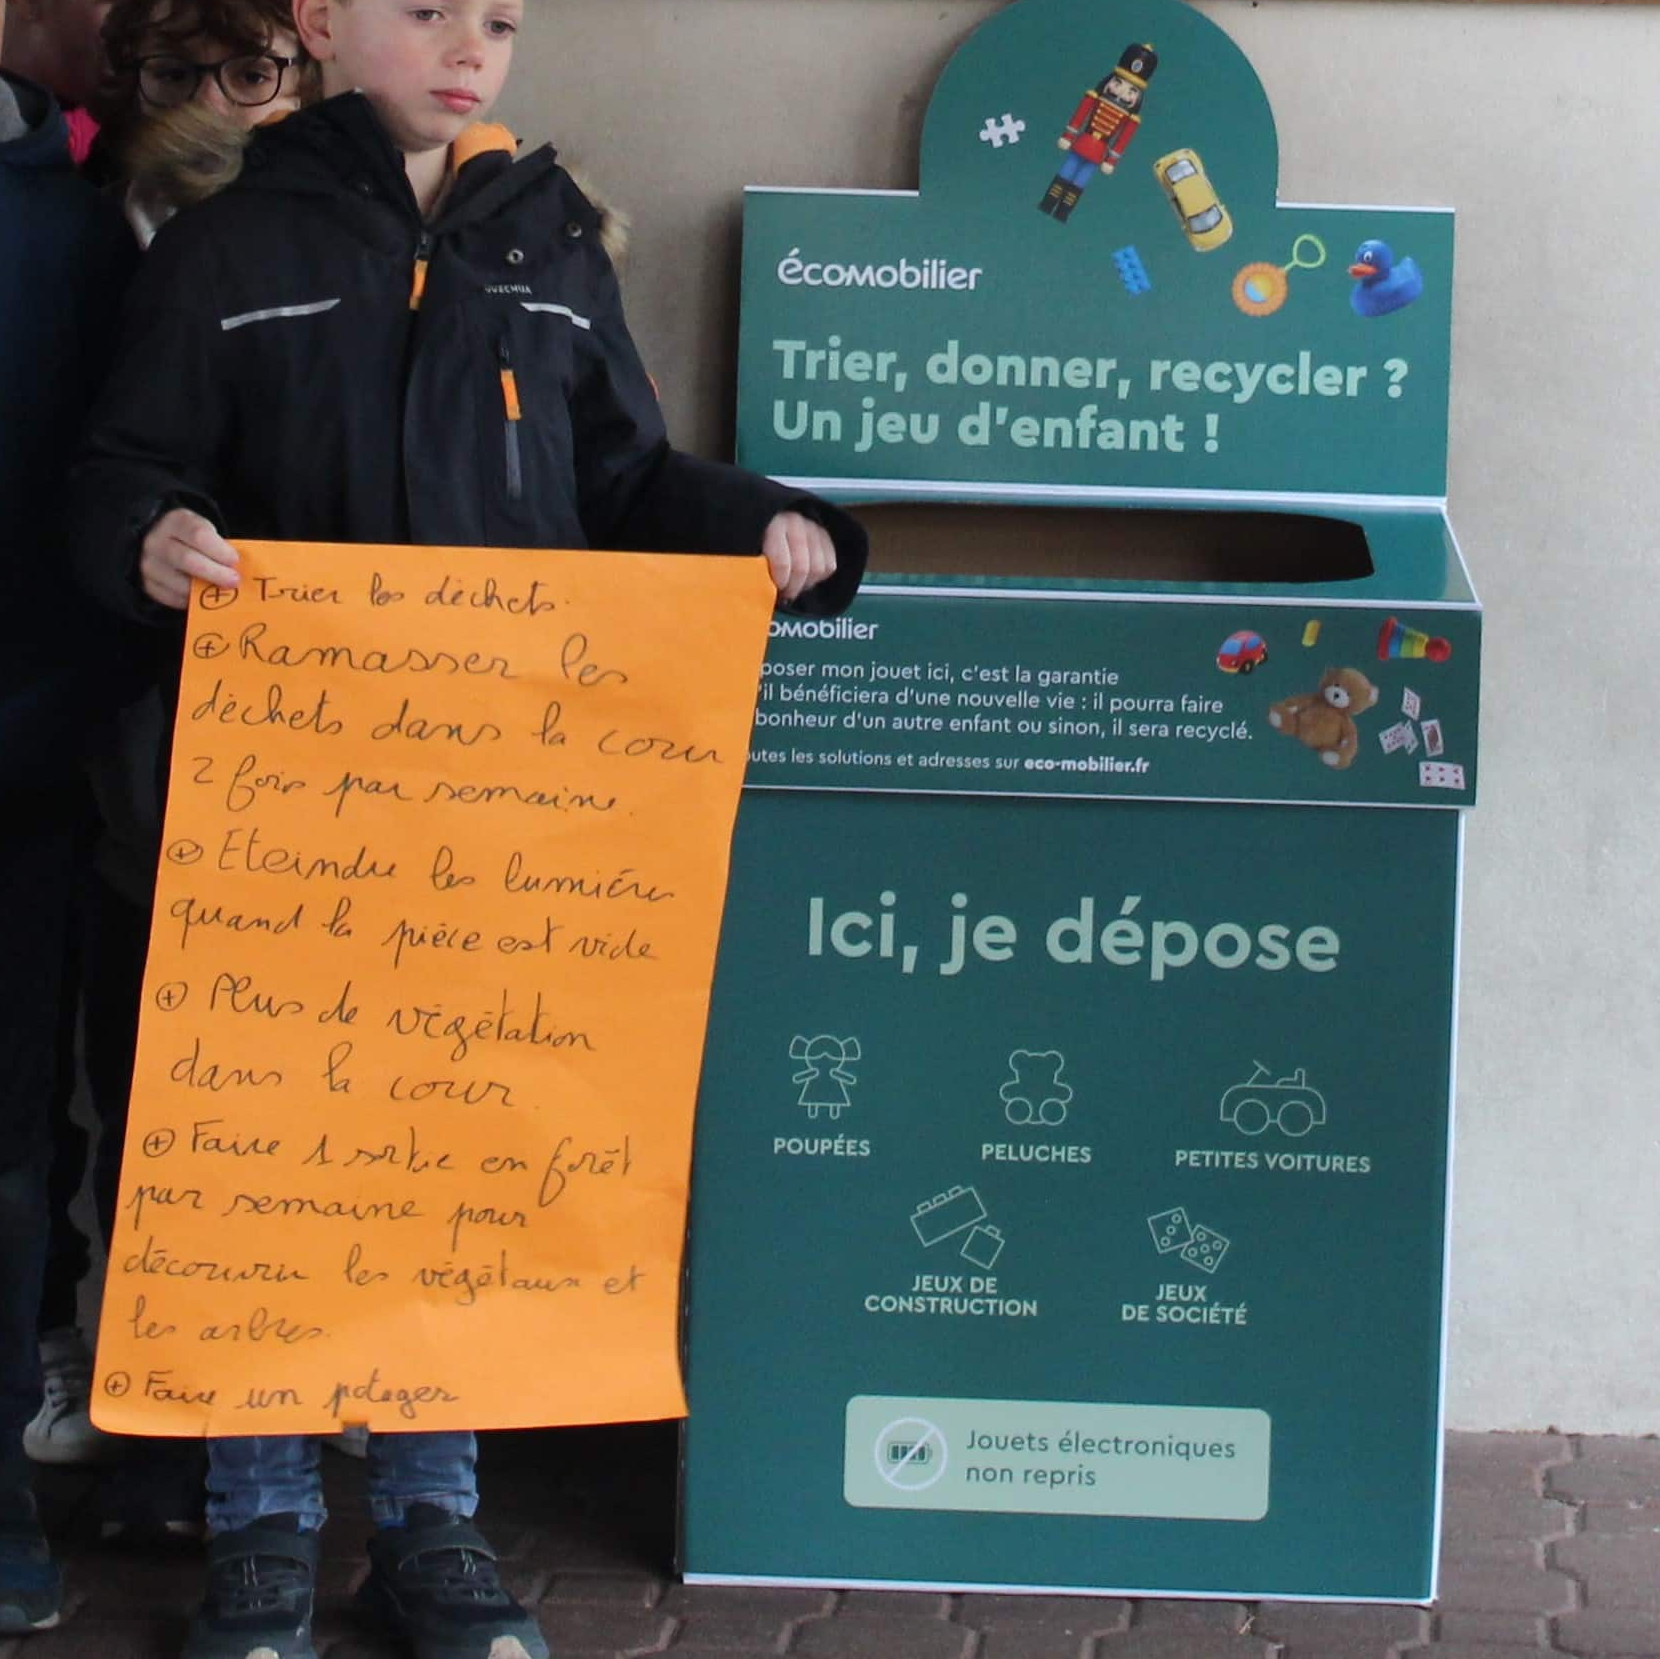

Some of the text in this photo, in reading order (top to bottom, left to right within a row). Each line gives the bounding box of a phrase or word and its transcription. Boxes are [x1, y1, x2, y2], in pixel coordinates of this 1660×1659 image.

[773, 336, 1409, 404] Trier, donner, recycler ?
[773, 397, 1220, 453] Un jeu d'enfant !
[254, 577, 341, 605] Trier
[370, 572, 404, 606] les
[768, 617, 879, 640] omobilier
[240, 623, 628, 686] Ramasser les
[761, 662, 1119, 687] poser mon jouet ici, c'est la garantie
[780, 683, 888, 704] bénéficiera
[895, 686, 950, 705] d'une
[957, 690, 1040, 709] nouvelle
[1047, 693, 1075, 709] vie
[1093, 693, 1103, 711] il
[1110, 697, 1174, 714] pourra
[1181, 695, 1223, 714] faire
[371, 699, 501, 745] dans
[532, 701, 566, 745] la
[598, 730, 725, 764] cour
[755, 708, 1252, 742] bonheur d'un autre enfant ou sinon, il sera recyclé.
[792, 749, 813, 764] les
[819, 749, 891, 766] solutions
[897, 753, 913, 767] et
[918, 752, 990, 768] adresses
[995, 757, 1019, 769] sur
[1024, 756, 1150, 773] eco-mobilier.fr
[193, 756, 214, 784] 2
[227, 754, 306, 812] fois
[323, 772, 413, 818] par
[430, 845, 476, 891] les
[170, 898, 304, 949] quand
[322, 896, 353, 937] la
[497, 916, 564, 954] est
[569, 929, 656, 960] vide
[808, 891, 1340, 980] Ici, je dépose
[210, 972, 596, 1062] Plus de végétation
[171, 1037, 282, 1091] dans
[322, 1040, 350, 1093] la
[192, 1119, 279, 1156] Faire
[303, 1134, 334, 1167] 1
[481, 1153, 528, 1174] en
[538, 1136, 632, 1207] forêt
[773, 1133, 870, 1157] POUPÉES
[982, 1143, 1092, 1163] PELUCHES
[1175, 1150, 1370, 1173] PETITES VOITURES
[126, 1182, 527, 1251] par semaine pour
[343, 1243, 389, 1284] les
[604, 1267, 645, 1294] et
[911, 1275, 997, 1294] JEUX DE
[864, 1295, 1038, 1317] CONSTRUCTION
[1155, 1283, 1207, 1303] JEUX
[132, 1295, 176, 1339] les
[1121, 1302, 1247, 1325] DE SOCIÉTÉ
[144, 1367, 457, 1420] Faire un potager
[966, 1429, 1236, 1465] Jouets électroniques
[966, 1461, 1097, 1492] non repris
